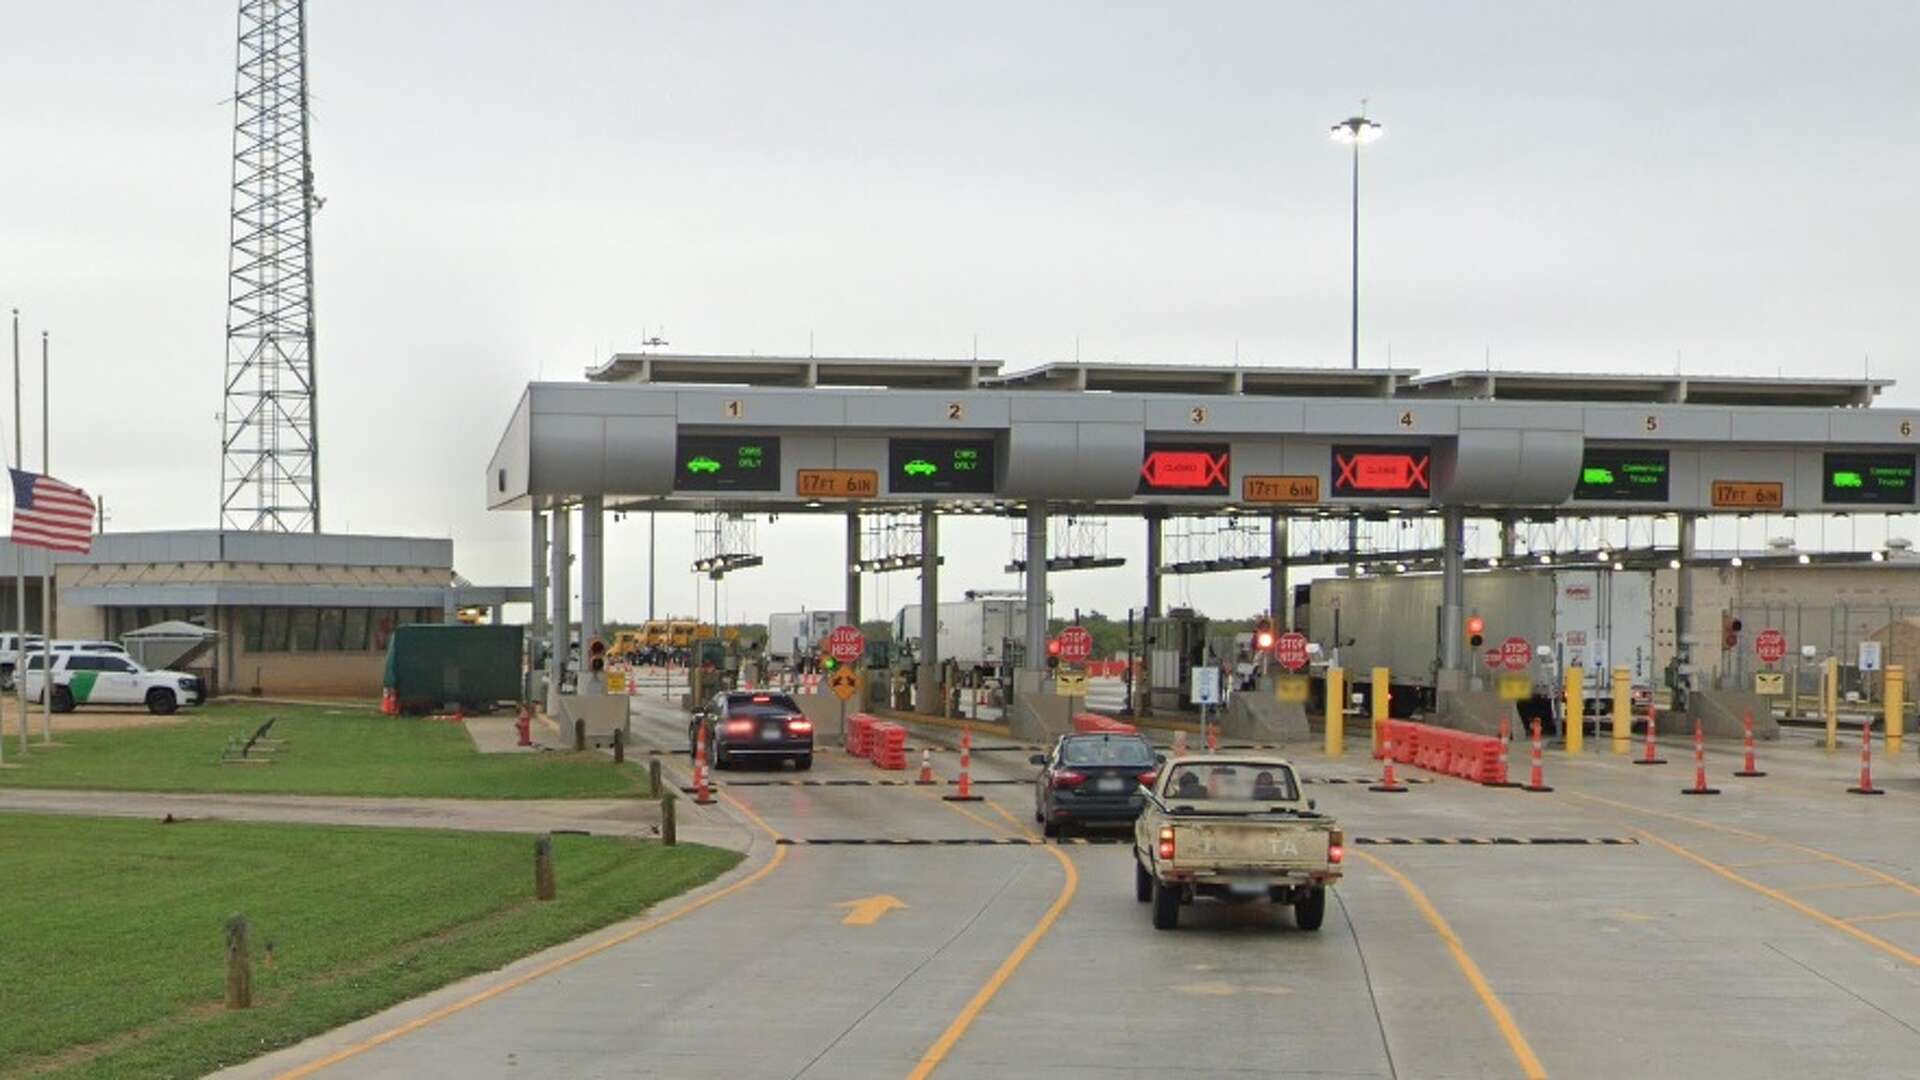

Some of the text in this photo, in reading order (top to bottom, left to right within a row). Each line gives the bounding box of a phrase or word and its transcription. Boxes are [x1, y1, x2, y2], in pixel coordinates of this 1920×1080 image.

[728, 401, 738, 416] 1
[949, 404, 961, 419] 2
[1191, 407, 1204, 423] 3
[1400, 411, 1412, 426] 4
[1646, 416, 1657, 431] 5
[1900, 421, 1911, 436] 6
[831, 629, 859, 643] STOP
[1060, 632, 1087, 643] STOP
[1758, 634, 1781, 645] STOP
[831, 643, 858, 656] HERE
[1280, 639, 1304, 649] STOP
[1504, 642, 1528, 653] STOP
[1758, 647, 1783, 657] HERE
